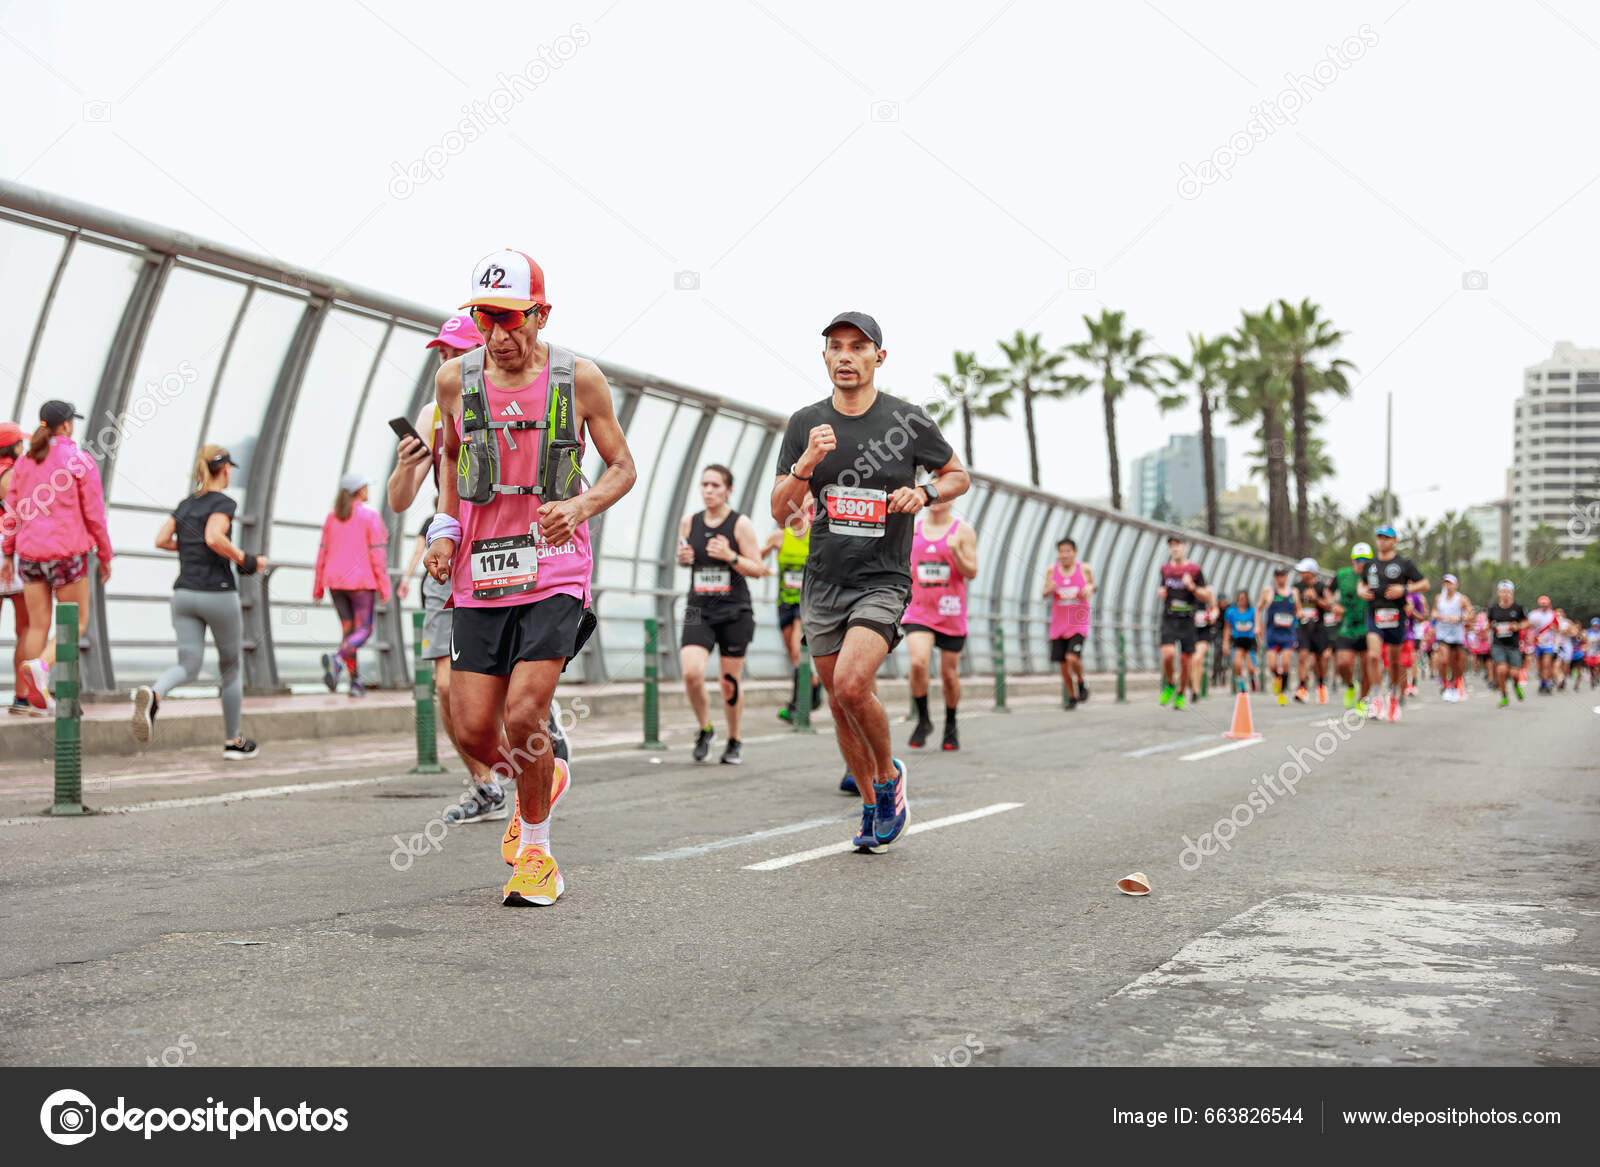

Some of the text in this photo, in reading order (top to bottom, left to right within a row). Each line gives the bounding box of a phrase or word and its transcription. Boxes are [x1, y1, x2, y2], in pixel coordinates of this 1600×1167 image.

[480, 268, 506, 289] 42
[836, 498, 875, 517] 5901
[536, 541, 576, 559] diclub
[480, 552, 519, 573] 1174
